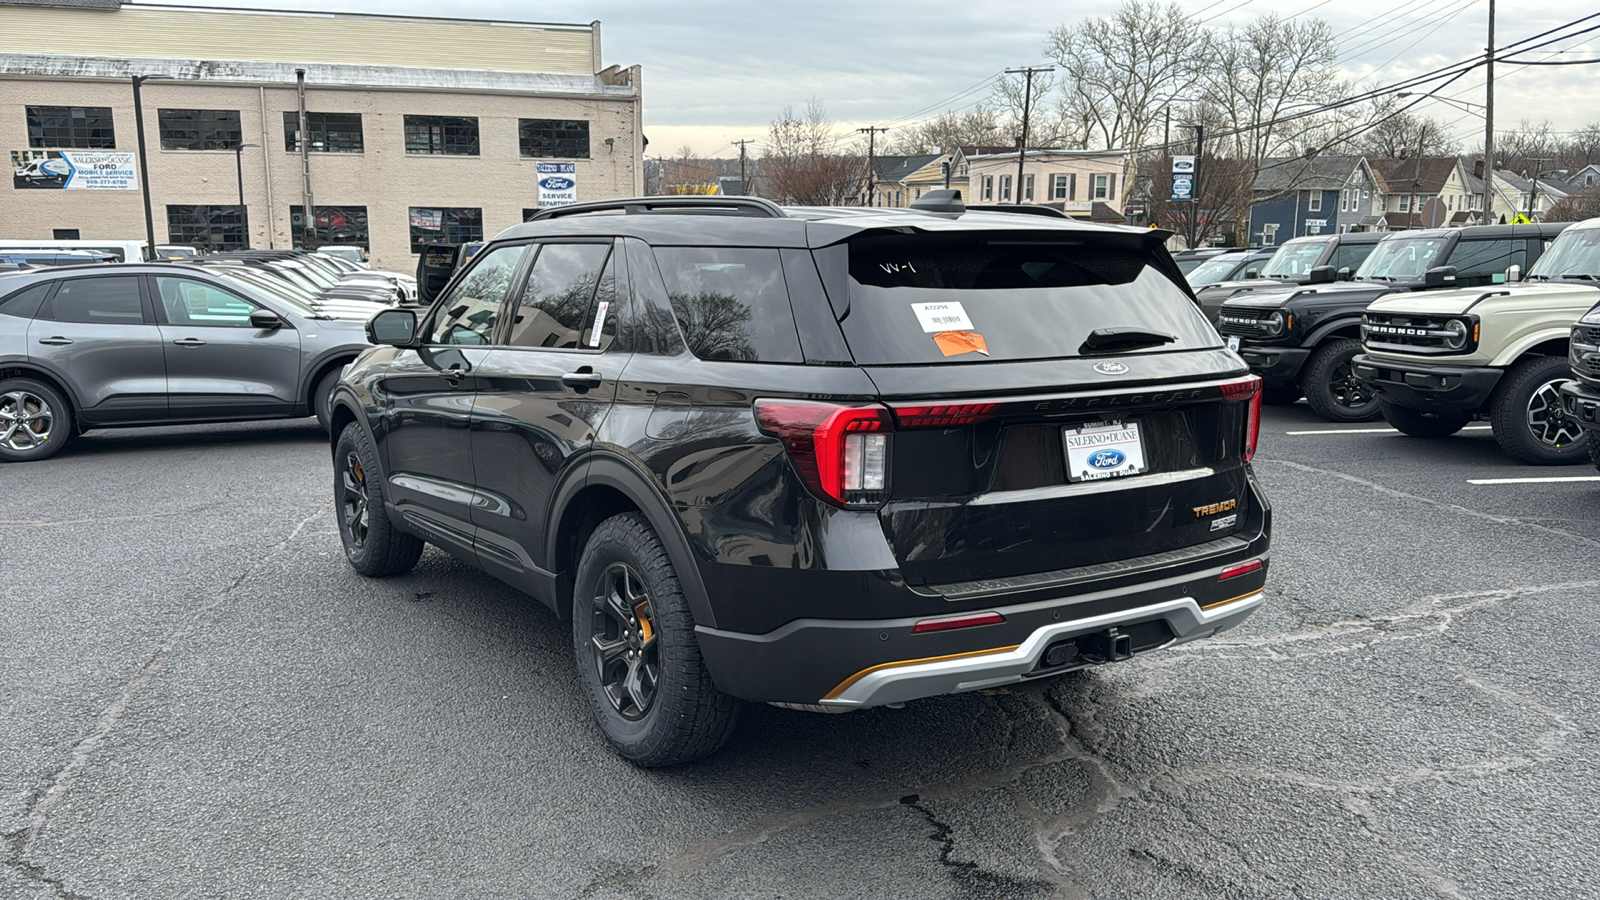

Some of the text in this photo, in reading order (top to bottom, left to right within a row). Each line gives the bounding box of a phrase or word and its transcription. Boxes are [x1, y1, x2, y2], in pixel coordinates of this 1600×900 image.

[1372, 325, 1427, 336] BRONCO
[1068, 430, 1138, 447] SALERNO DUANE
[1094, 452, 1119, 467] Ford
[1081, 467, 1140, 481] SALERNO DUANE
[1192, 498, 1237, 517] TREMOR
